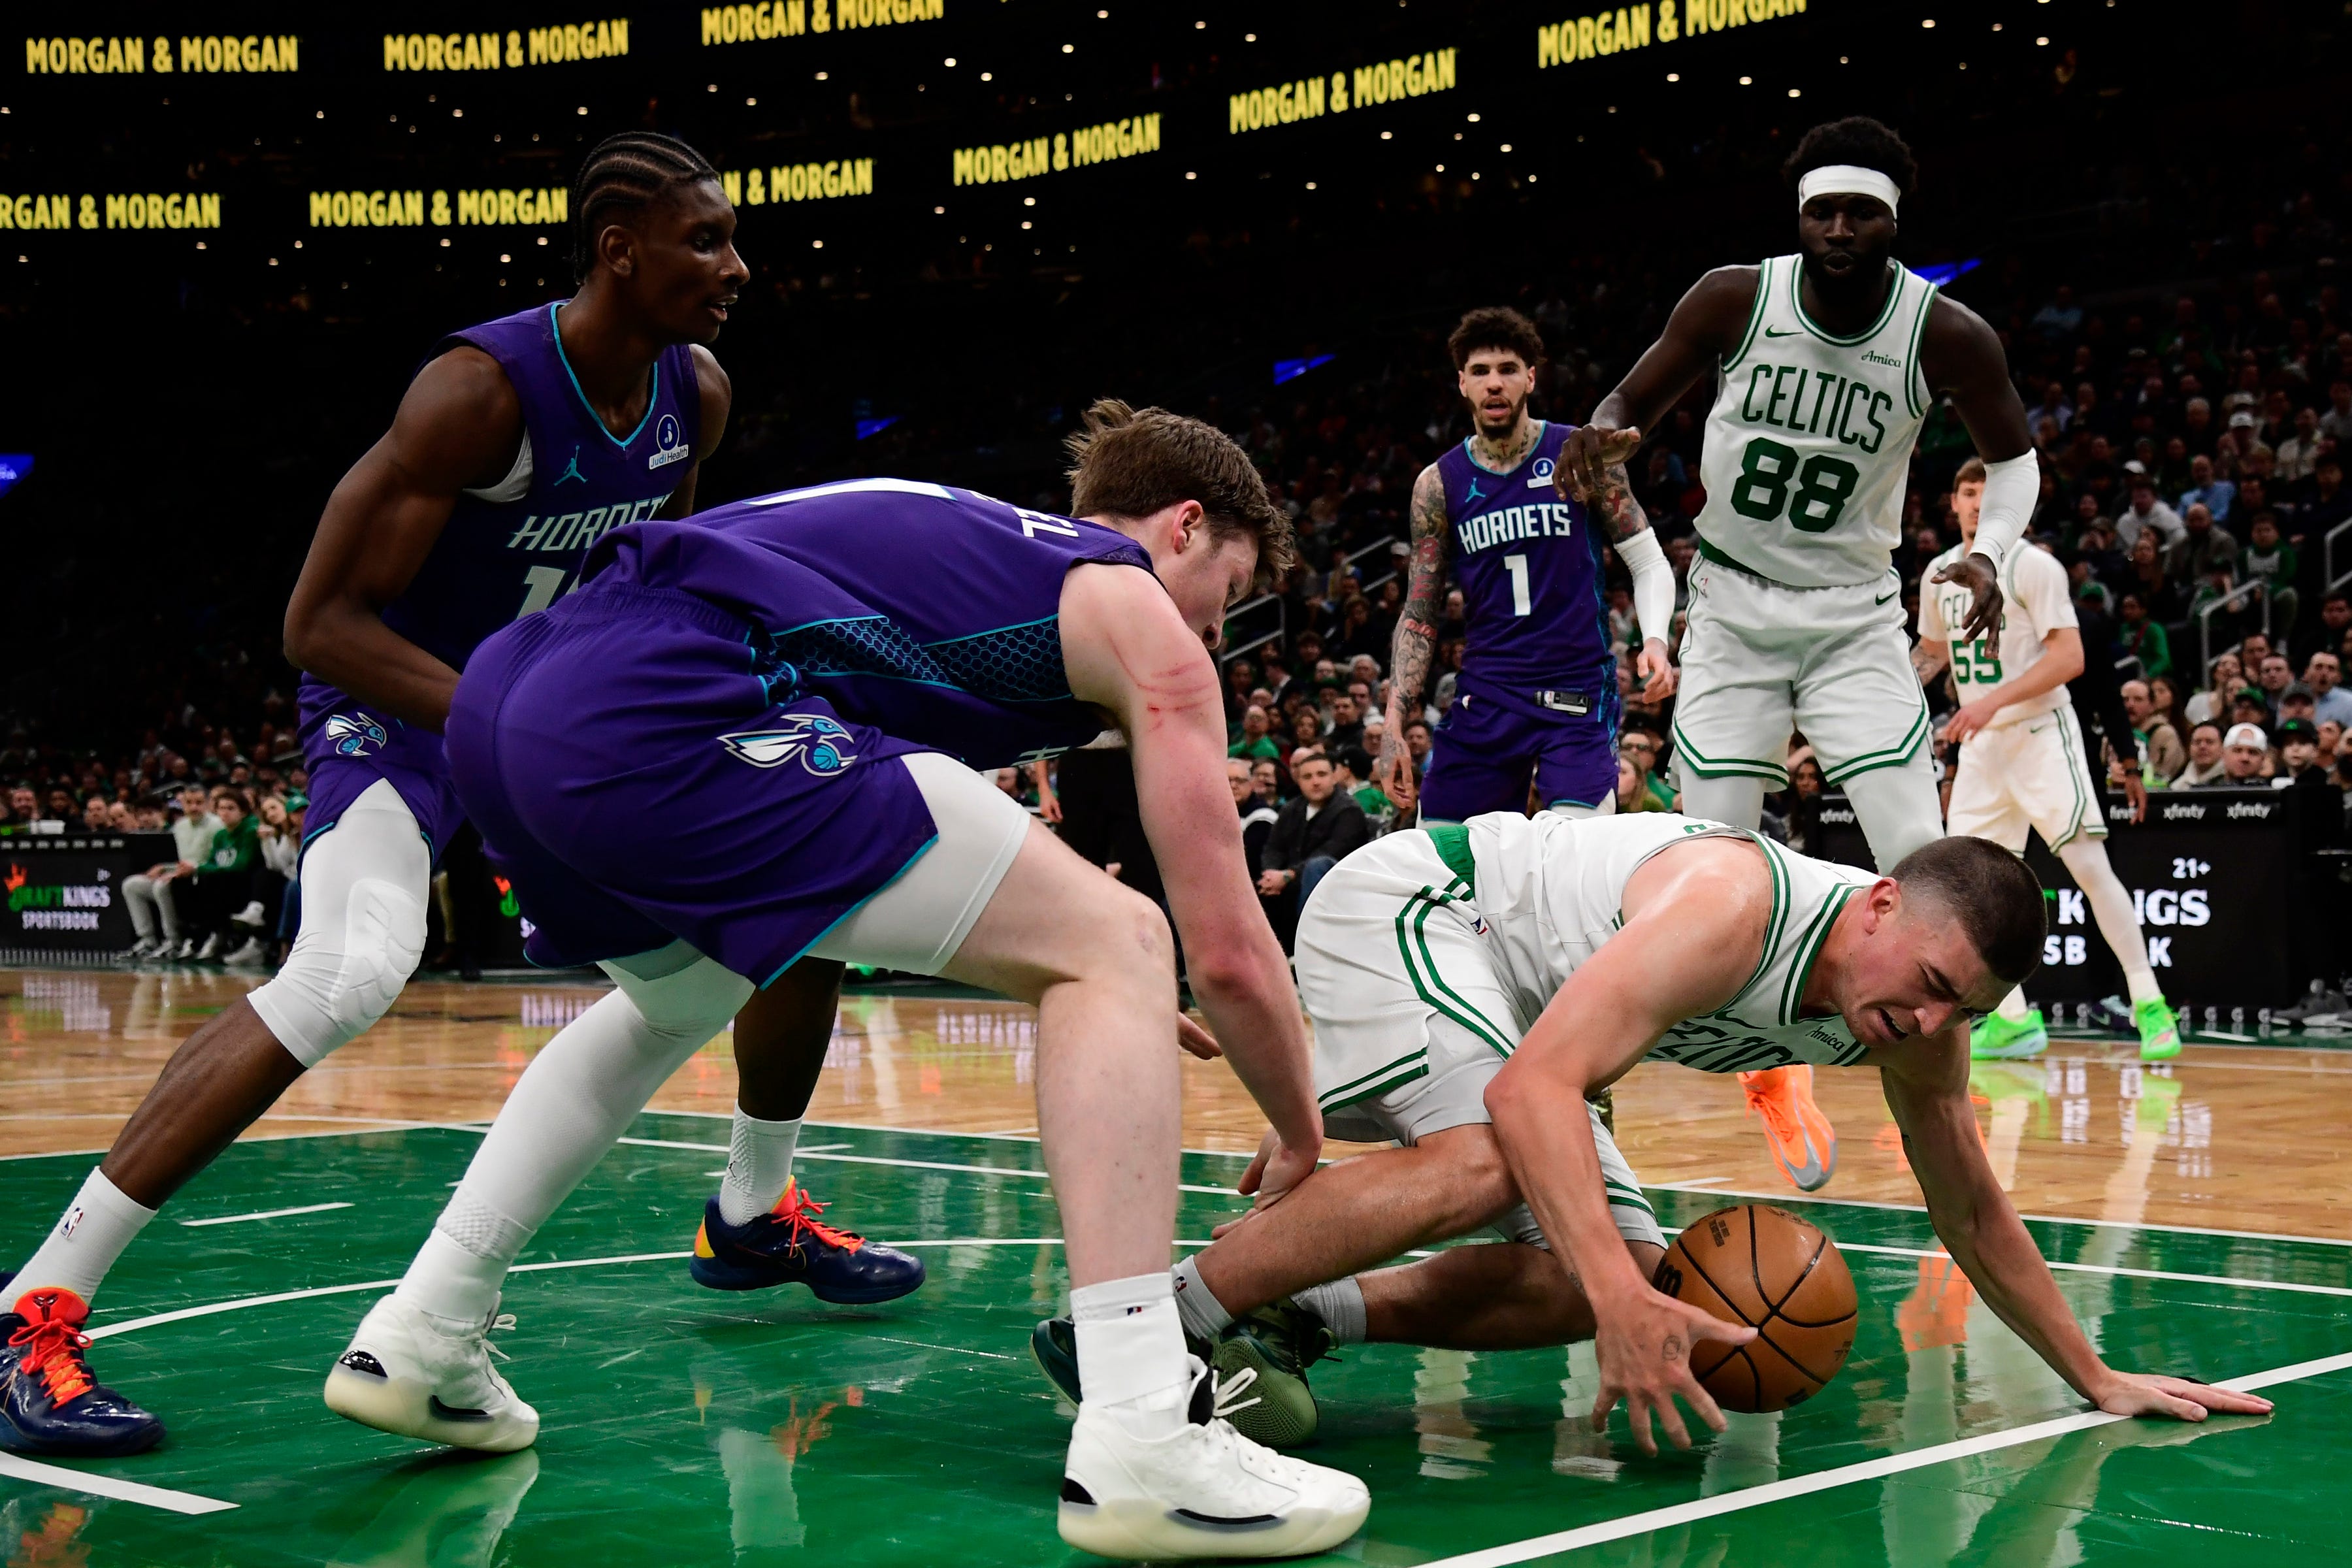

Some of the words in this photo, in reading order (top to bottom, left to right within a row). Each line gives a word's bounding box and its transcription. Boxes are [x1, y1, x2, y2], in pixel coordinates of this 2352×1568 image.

[384, 33, 500, 71] MORGAN
[505, 31, 524, 68] &
[529, 19, 629, 65] MORGAN
[702, 0, 806, 46] MORGAN
[811, 0, 831, 33] &
[1538, 3, 1650, 69] MORGAN
[1657, 0, 1678, 42] &
[26, 37, 144, 74] MORGAN
[152, 37, 173, 73] &
[180, 35, 299, 73] MORGAN
[1230, 76, 1325, 135] MORGAN
[1330, 72, 1348, 113] &
[1354, 47, 1456, 108] MORGAN
[953, 136, 1049, 186] MORGAN
[1053, 133, 1070, 171] &
[1072, 112, 1160, 167] MORGAN
[747, 169, 765, 206] &
[771, 158, 873, 203] MORGAN
[0, 194, 71, 230] RGAN
[78, 193, 99, 230] &
[106, 193, 220, 230] MORGAN
[310, 191, 424, 227] MORGAN
[431, 190, 451, 226] &
[458, 188, 568, 225] MORGAN
[1861, 350, 1901, 368] Amica
[1742, 364, 1893, 454] CELTICS
[651, 453, 666, 467] Judi
[667, 447, 687, 462] Health
[1731, 437, 1860, 532] 88
[507, 490, 674, 551] HORNET
[1458, 504, 1571, 554] HORNETS
[516, 565, 580, 619] 1
[1504, 554, 1531, 616] 1
[1952, 640, 2002, 683] 55
[2163, 803, 2206, 820] xfinity
[2227, 801, 2271, 819] xfinity
[2172, 857, 2211, 879] 21+
[1805, 1025, 1845, 1052] Amica
